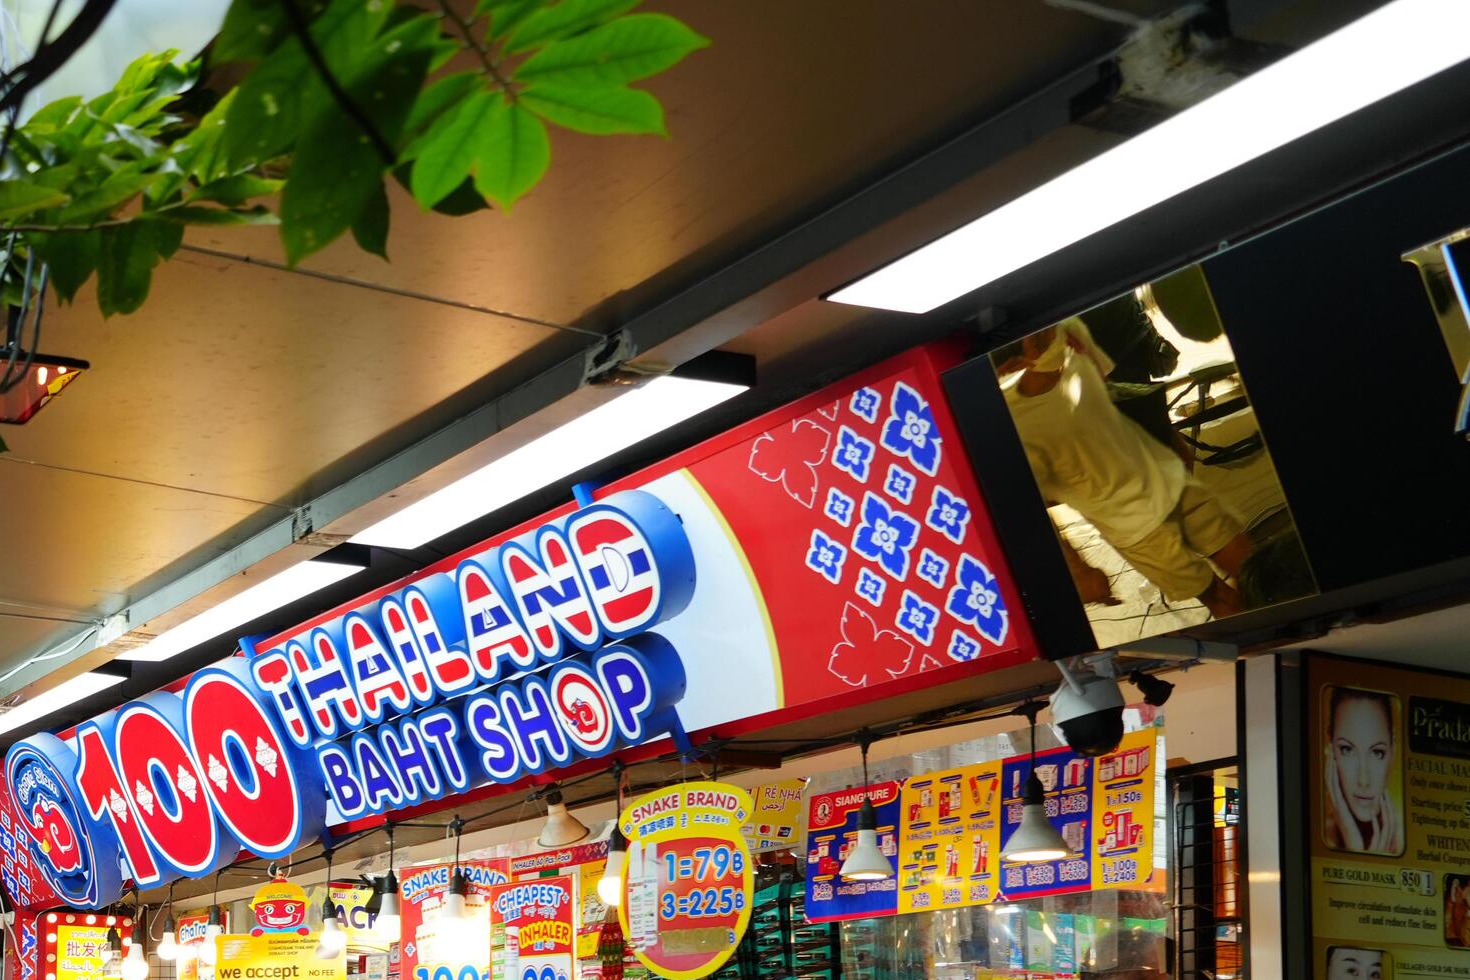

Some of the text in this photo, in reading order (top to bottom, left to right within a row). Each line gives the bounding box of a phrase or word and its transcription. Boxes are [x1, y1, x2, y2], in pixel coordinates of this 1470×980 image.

[254, 508, 662, 746] THAILAND
[320, 645, 651, 818] BAHT SHOP
[1411, 704, 1470, 742] Prada
[78, 670, 298, 886] 100
[633, 791, 738, 824] SNAKE BRAND
[513, 860, 535, 871] INHALER
[1322, 867, 1344, 880] PURE
[1346, 869, 1370, 882] GOLD
[1372, 872, 1396, 885] MASK
[1401, 871, 1420, 888] 850
[402, 867, 507, 898] SNAKE RAND
[498, 884, 563, 912] CHEAPEST
[1372, 916, 1383, 925] and
[519, 922, 571, 949] INHALER
[220, 967, 241, 979] we
[246, 965, 299, 980] accept
[322, 968, 334, 976] FEE
